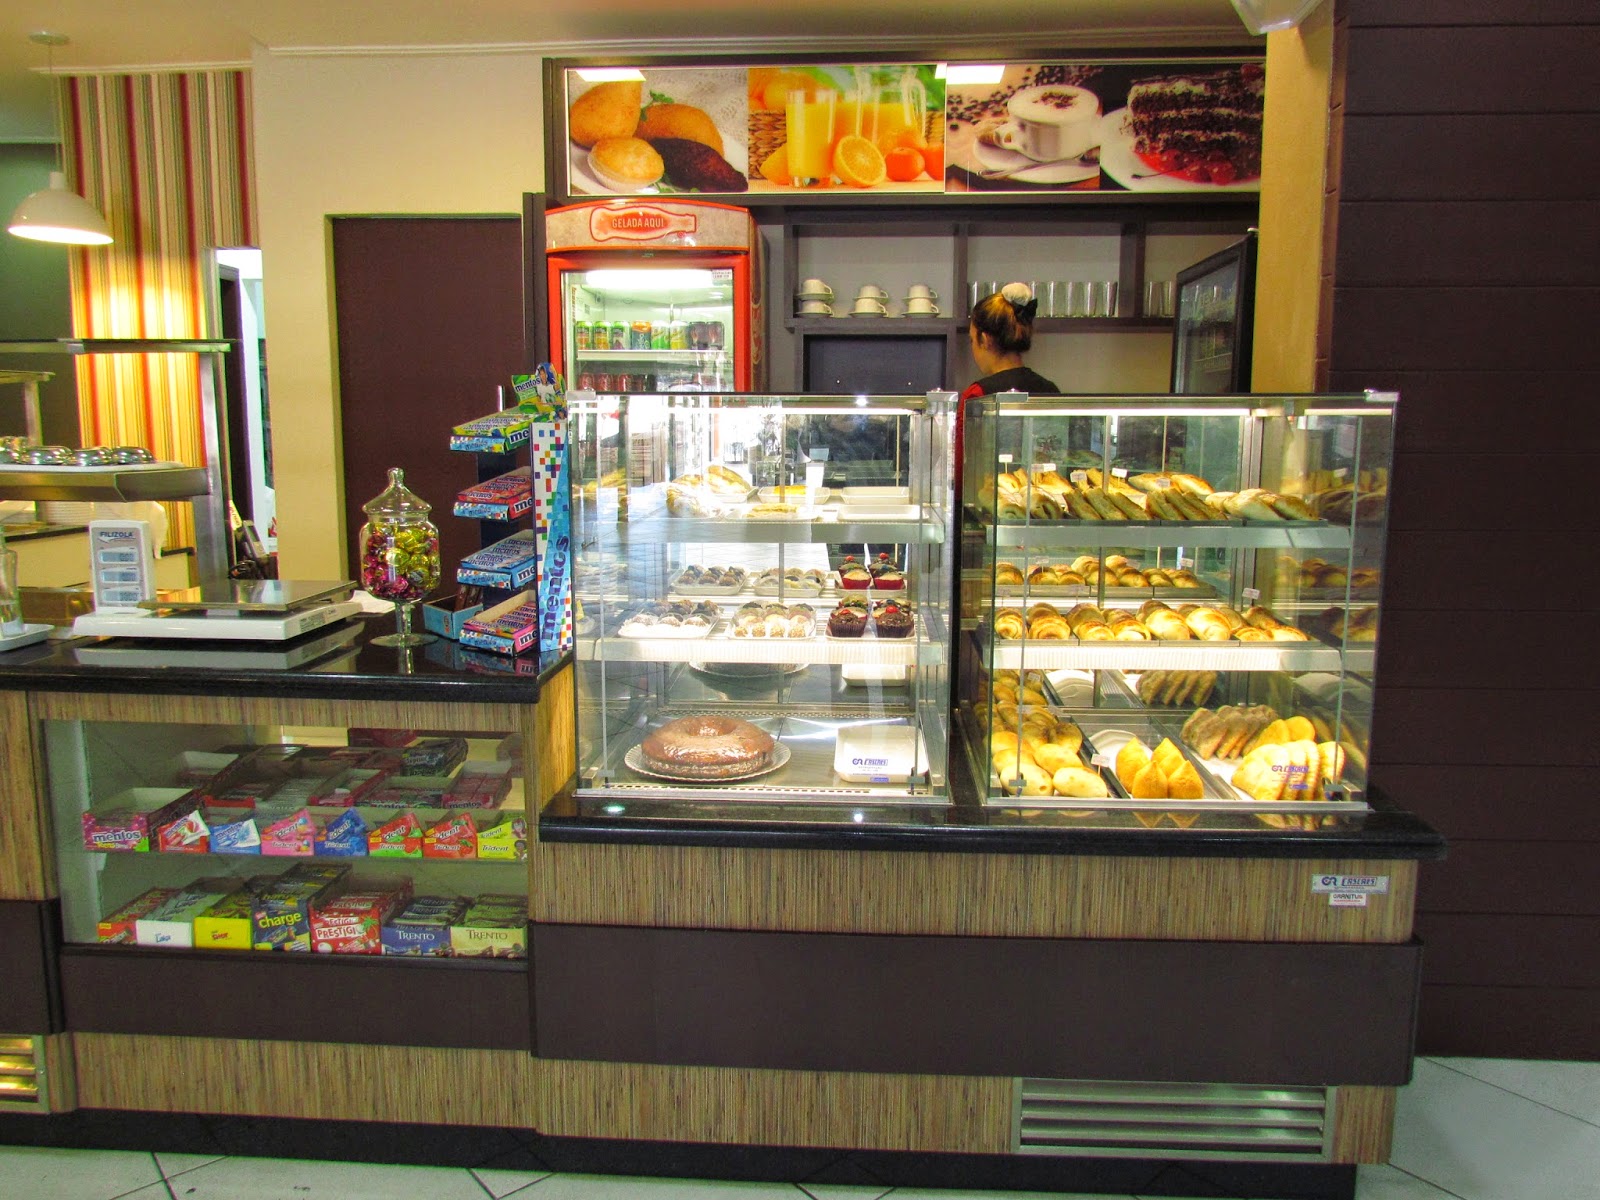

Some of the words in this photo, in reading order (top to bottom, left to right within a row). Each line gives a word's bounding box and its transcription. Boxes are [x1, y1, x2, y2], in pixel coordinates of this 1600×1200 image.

[612, 217, 643, 228] GELADA
[644, 217, 665, 228] AQUI
[514, 377, 541, 392] mentos
[541, 535, 570, 641] mentos
[93, 830, 141, 843] mentos
[482, 844, 509, 852] Trident
[259, 912, 302, 929] charge
[396, 930, 435, 940] TRENTO
[466, 929, 508, 939] TRENTO
